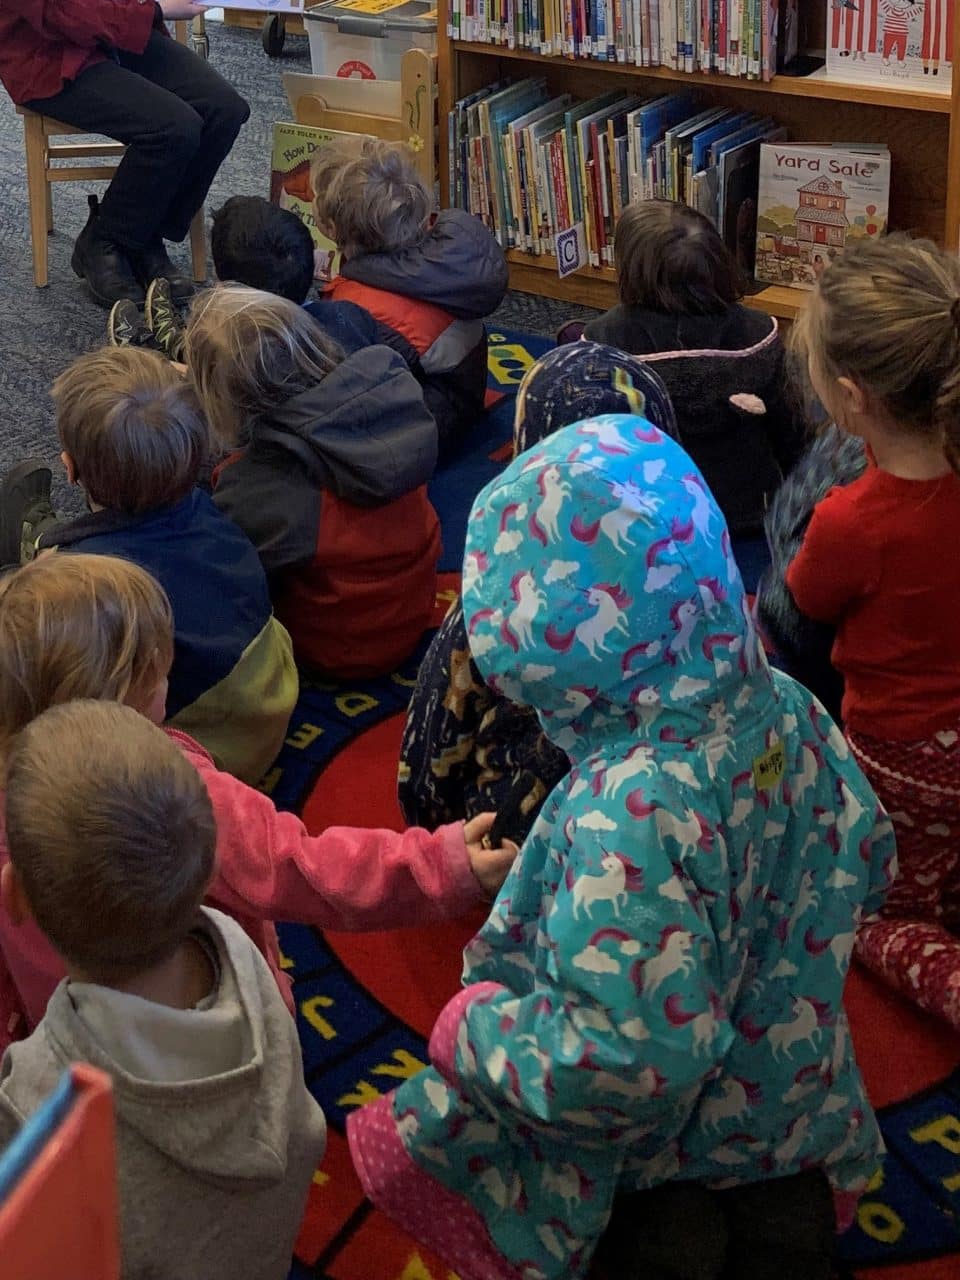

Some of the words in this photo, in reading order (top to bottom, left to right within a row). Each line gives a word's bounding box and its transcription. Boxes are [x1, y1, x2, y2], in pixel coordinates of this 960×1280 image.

[774, 152, 820, 172] Yard
[828, 159, 874, 178] Sale
[564, 240, 575, 263] C
